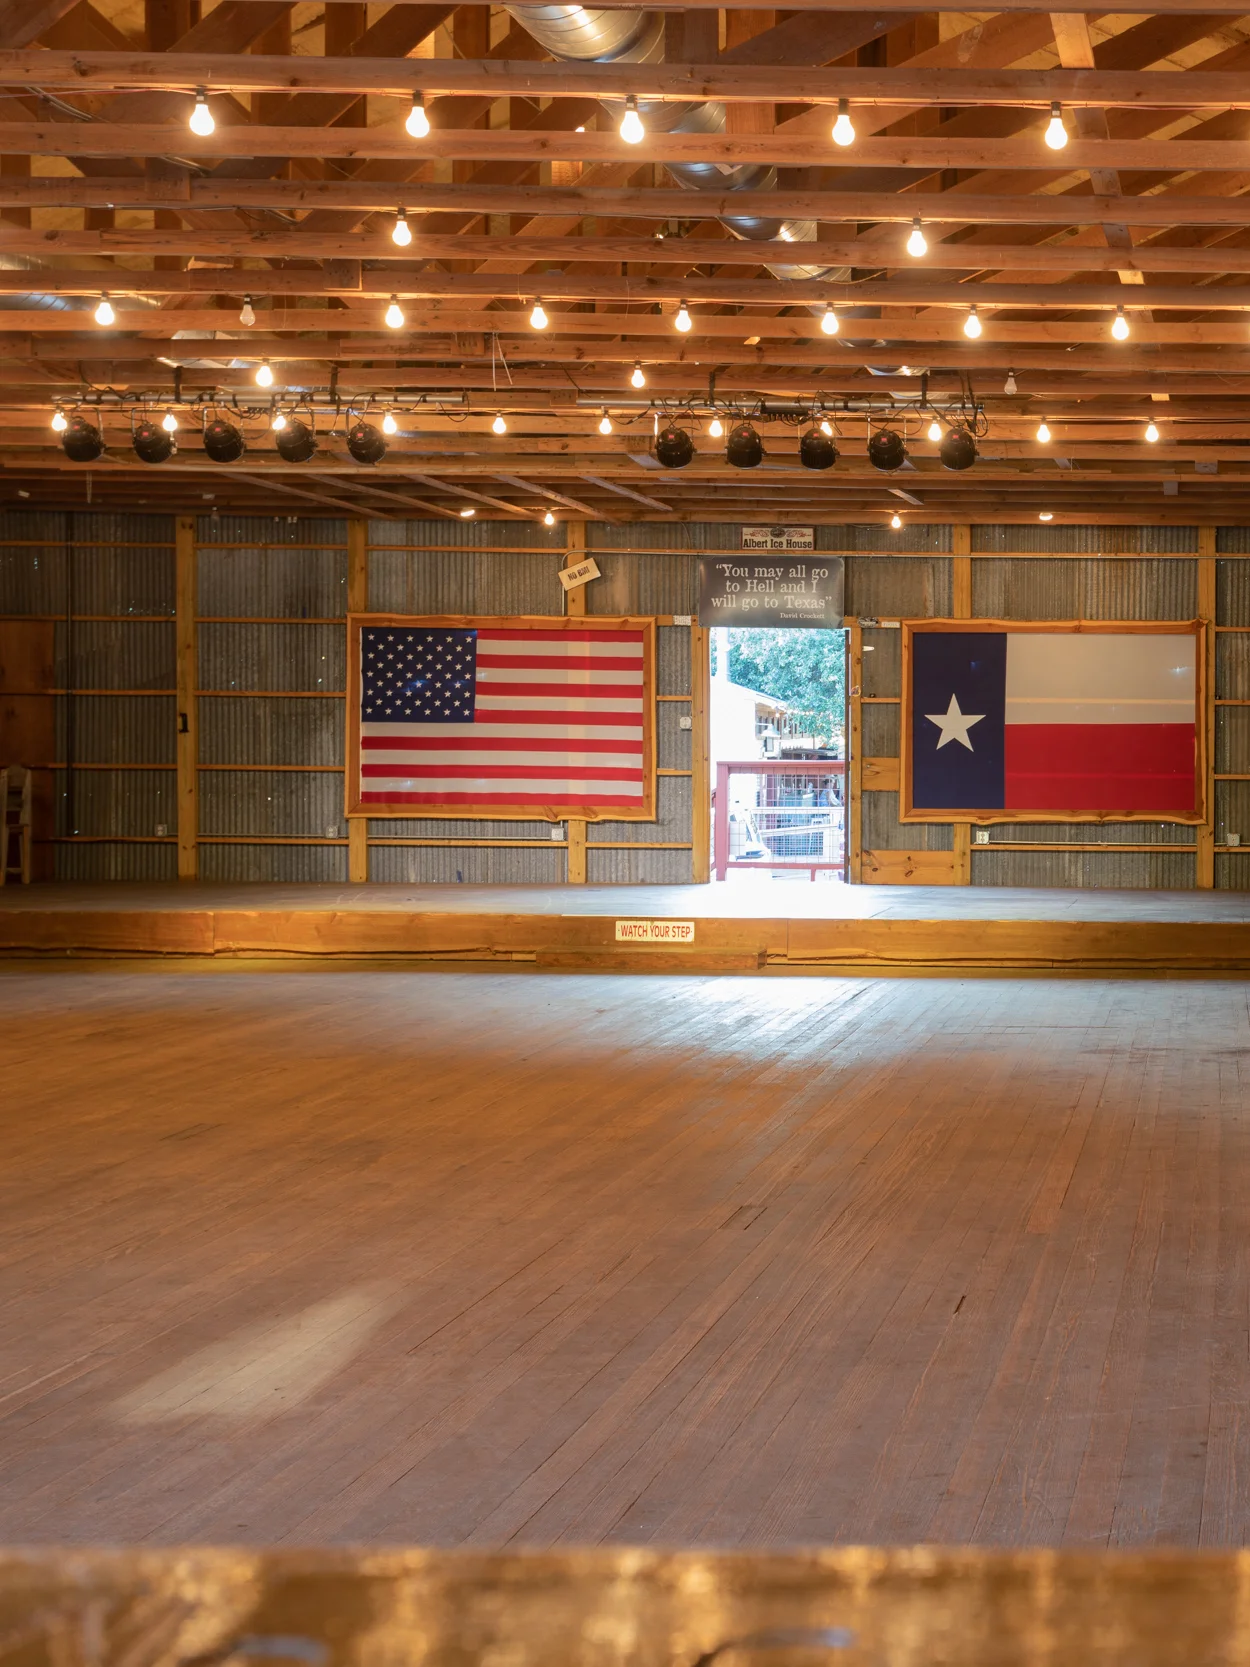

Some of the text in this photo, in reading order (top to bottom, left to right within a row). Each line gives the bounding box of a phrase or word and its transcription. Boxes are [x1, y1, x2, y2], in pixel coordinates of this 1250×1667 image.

[743, 539, 812, 549] Albert Ice House
[568, 572, 577, 581] NO
[754, 567, 784, 580] may
[789, 565, 806, 578] all
[811, 568, 829, 581] go
[725, 579, 817, 593] to Hell and I
[711, 595, 736, 608] will
[741, 597, 759, 611] go
[764, 597, 778, 608] to
[620, 924, 691, 938] WATCH YOUR STEP
